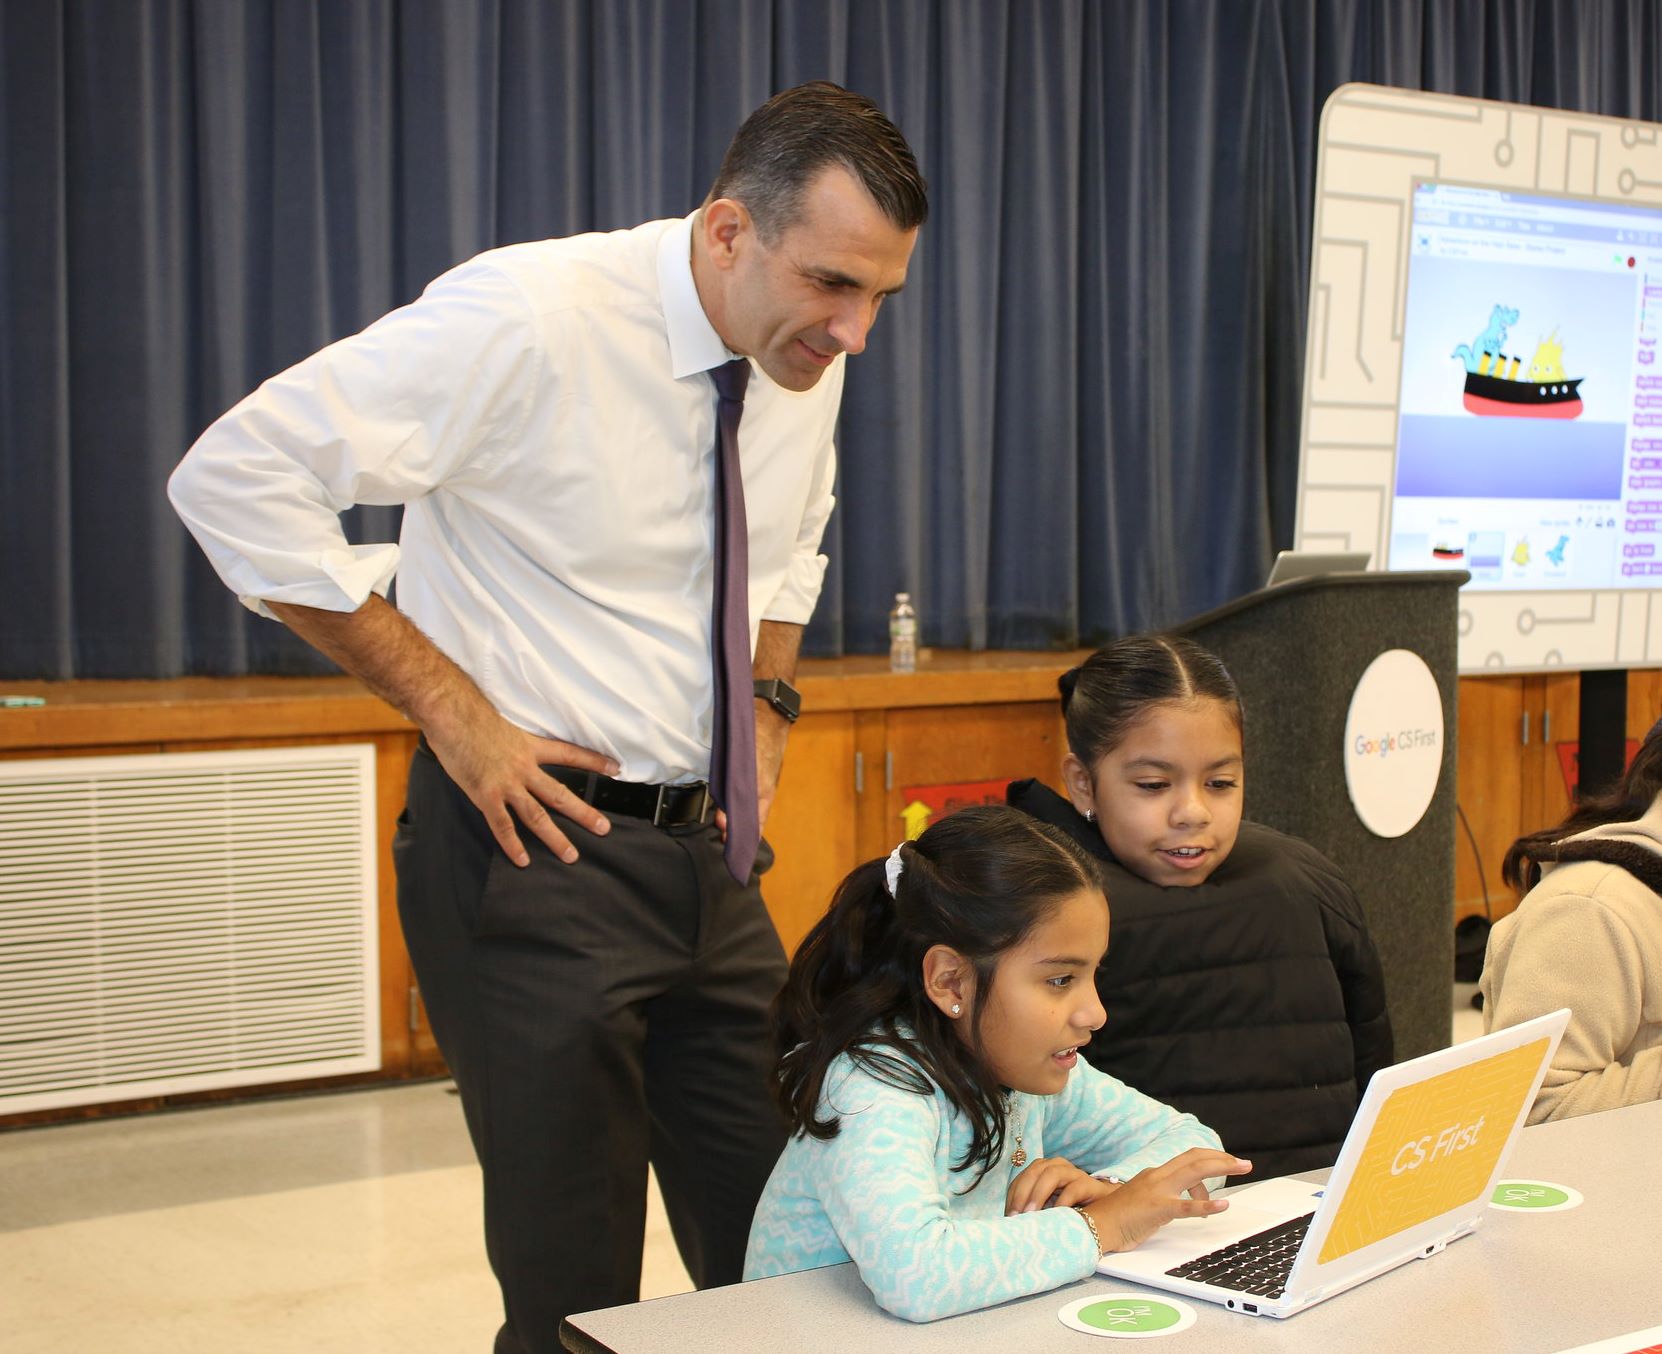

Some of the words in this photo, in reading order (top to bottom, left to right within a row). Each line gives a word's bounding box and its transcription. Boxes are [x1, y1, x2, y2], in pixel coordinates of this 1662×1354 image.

[1355, 732, 1396, 758] Google
[1398, 731, 1413, 750] CS
[1414, 728, 1436, 747] First
[1391, 1135, 1431, 1176] CS
[1429, 1115, 1485, 1162] First
[1503, 1189, 1531, 1202] OK
[1106, 1307, 1138, 1325] OK
